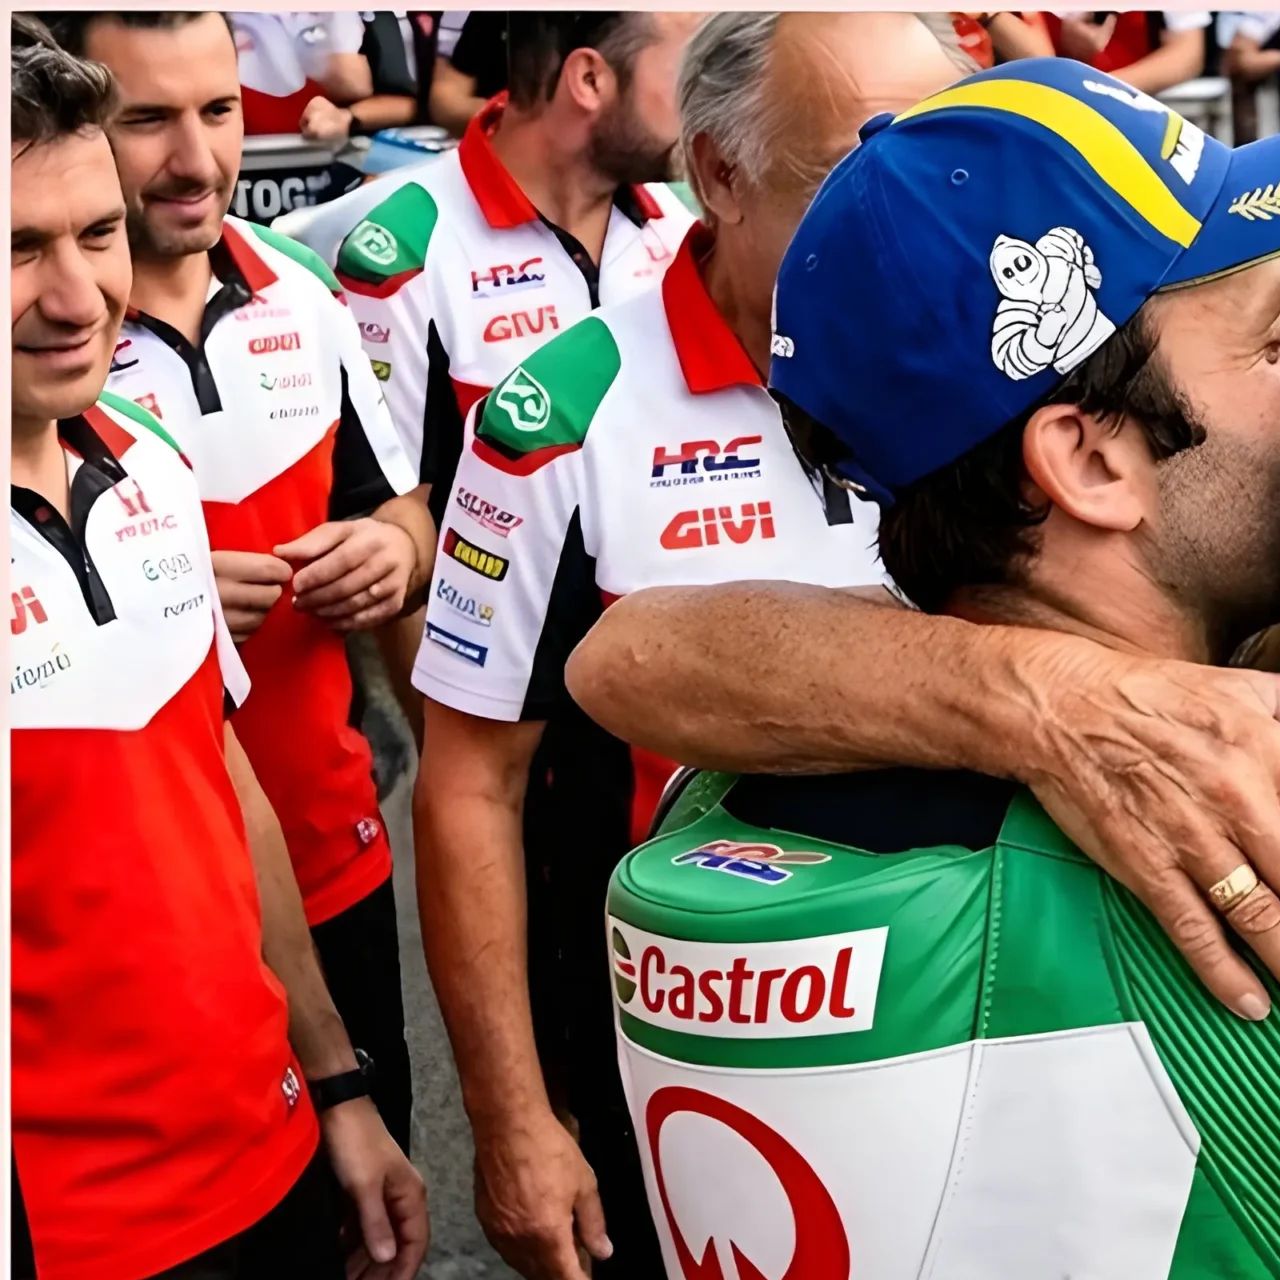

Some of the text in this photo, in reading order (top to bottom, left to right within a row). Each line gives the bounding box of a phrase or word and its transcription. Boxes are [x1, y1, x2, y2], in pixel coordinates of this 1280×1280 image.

[651, 435, 763, 477] HRC
[659, 501, 776, 550] GIVI
[639, 945, 856, 1025] Castrol
